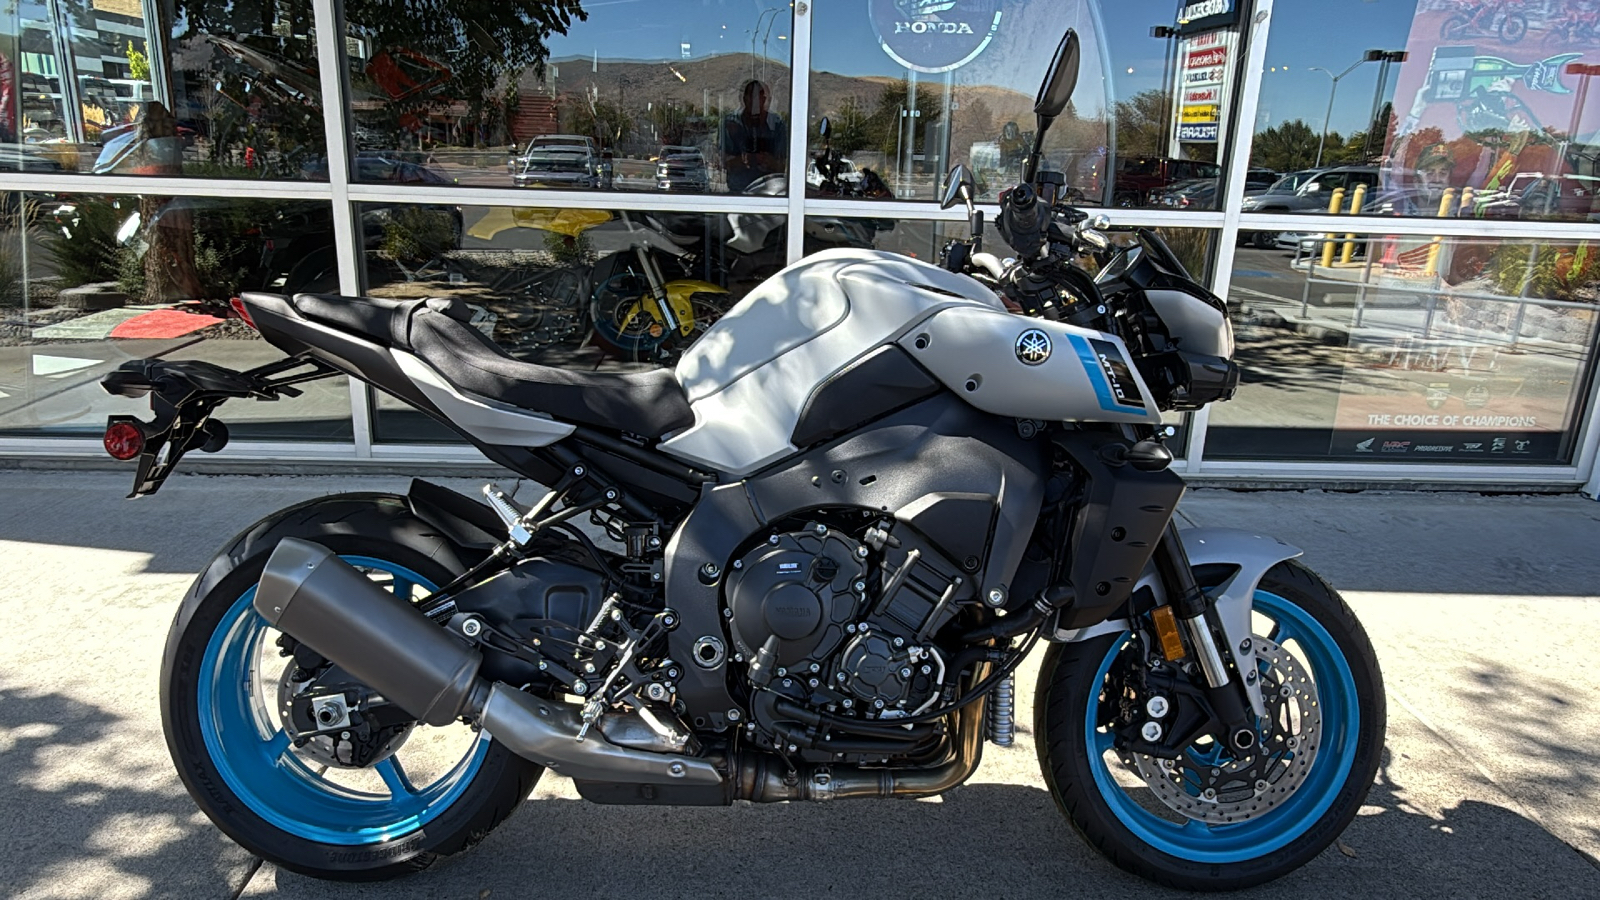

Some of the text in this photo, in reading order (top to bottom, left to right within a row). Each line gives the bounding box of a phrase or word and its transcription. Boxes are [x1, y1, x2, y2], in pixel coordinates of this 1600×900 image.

[895, 21, 974, 34] HONDA
[1098, 353, 1125, 398] MT-10
[1367, 414, 1537, 427] THE CHOICE OF CHAMPIONS
